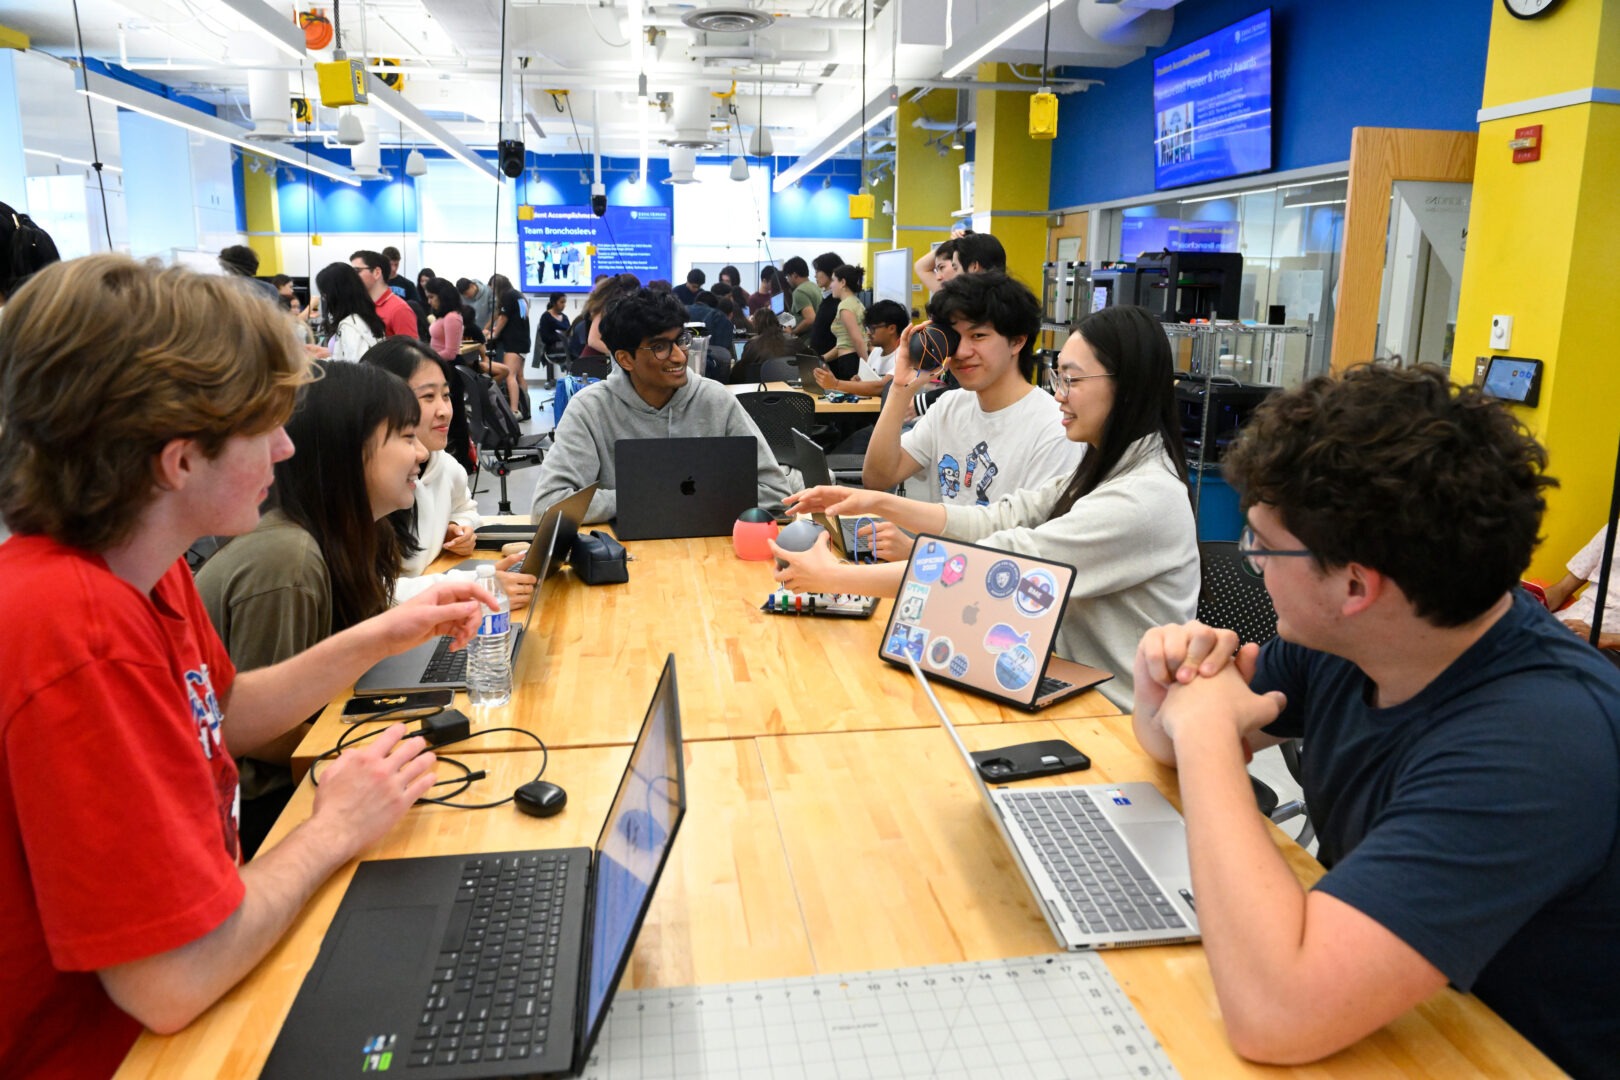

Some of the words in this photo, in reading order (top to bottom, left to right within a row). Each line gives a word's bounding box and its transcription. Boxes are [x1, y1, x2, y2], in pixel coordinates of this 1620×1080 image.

[1208, 72, 1213, 83] &
[1214, 64, 1233, 81] Propel
[1233, 56, 1257, 73] Awards
[524, 227, 543, 235] Team
[545, 227, 597, 235] Bronchosleeve
[1006, 970, 1019, 978] 15
[1060, 965, 1072, 973] 17
